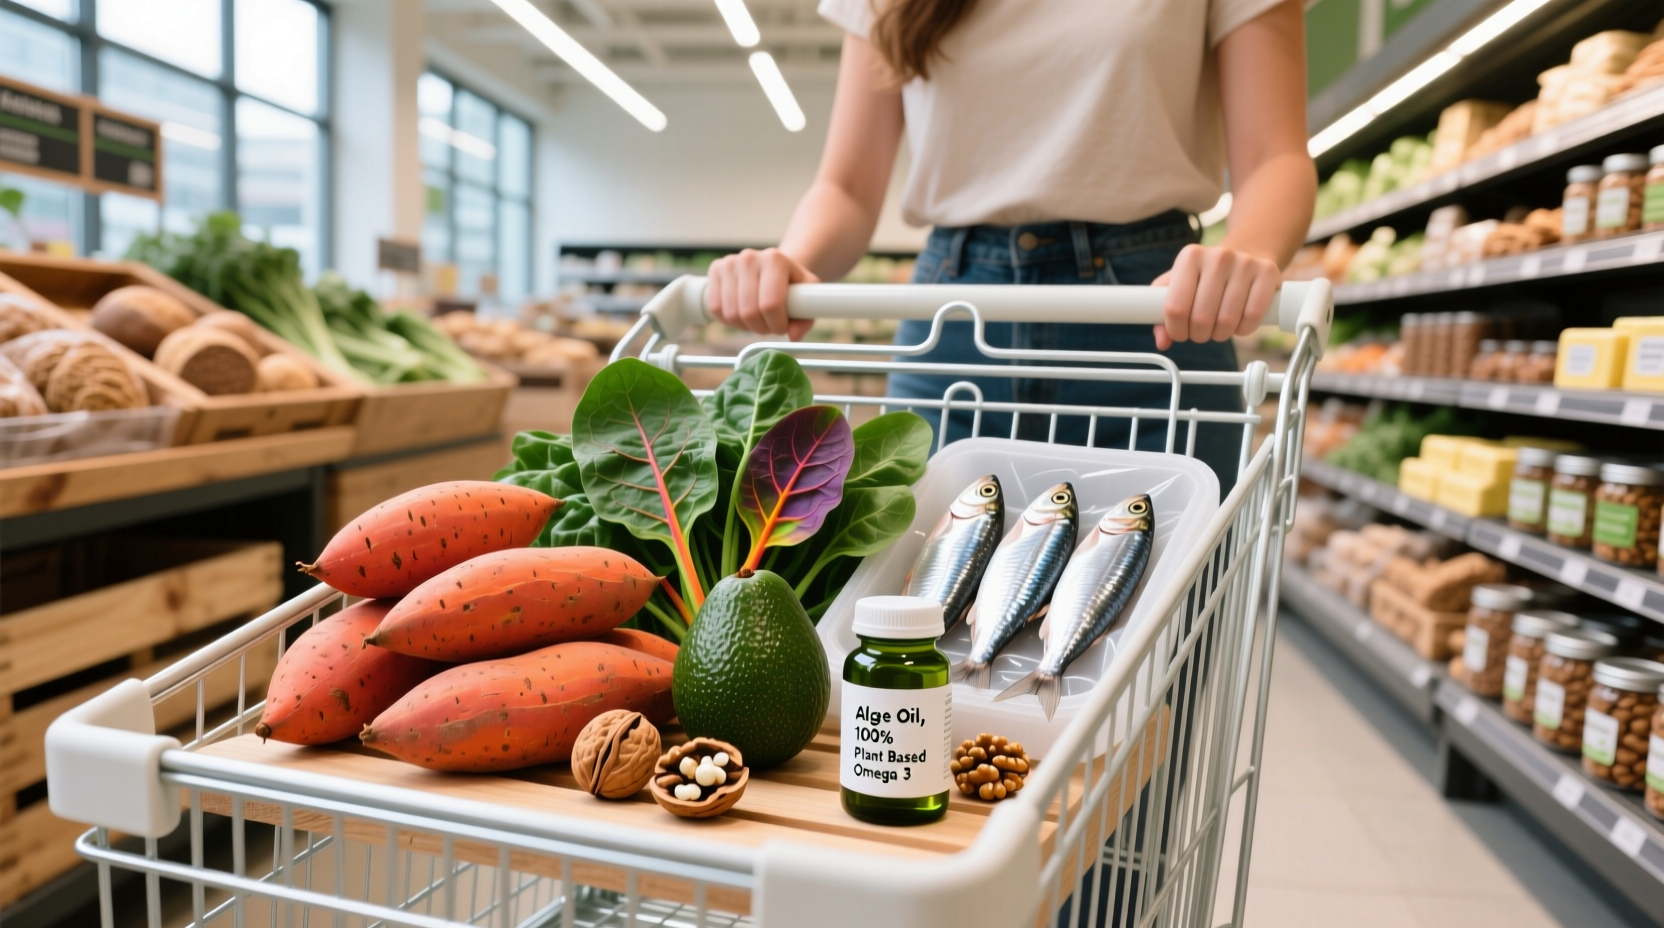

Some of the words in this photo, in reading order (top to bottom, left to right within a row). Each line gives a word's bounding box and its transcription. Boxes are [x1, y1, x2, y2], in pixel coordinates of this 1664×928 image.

[897, 707, 925, 727] Oil,
[855, 726, 894, 744] 100%
[854, 746, 883, 762] Plant
[888, 749, 926, 763] Based
[854, 763, 898, 783] Omega
[903, 767, 911, 780] 3
